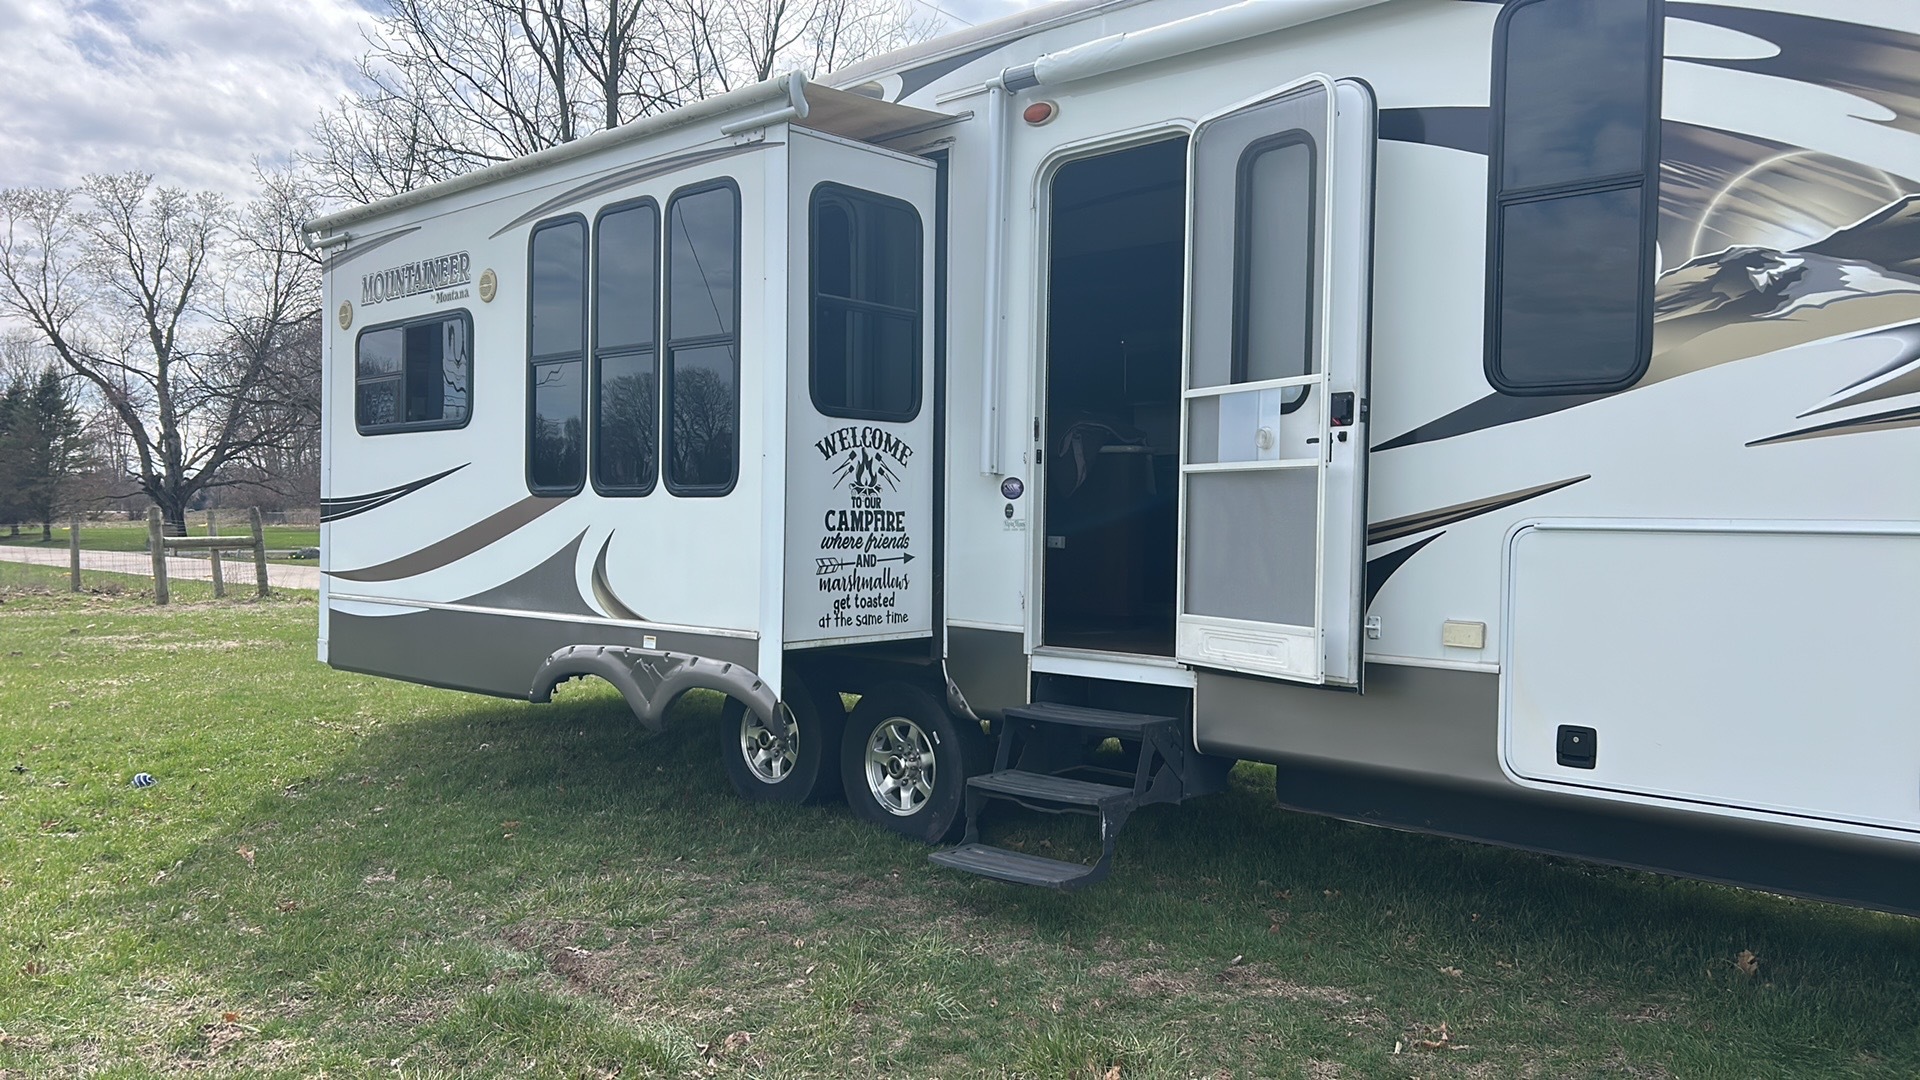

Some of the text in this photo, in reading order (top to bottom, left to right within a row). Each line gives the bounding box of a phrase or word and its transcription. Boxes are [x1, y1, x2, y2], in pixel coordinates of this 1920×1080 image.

[361, 251, 471, 306] MOUNTAINEER
[436, 288, 470, 304] Montana
[815, 426, 914, 468] WELCOME
[851, 496, 882, 509] TO OUR
[824, 510, 905, 532] CAMPFIRE
[820, 533, 910, 553] where friends
[855, 554, 877, 568] AND
[819, 567, 910, 593] marshmallows
[833, 592, 895, 614] get toasted
[818, 611, 909, 628] at the same time
